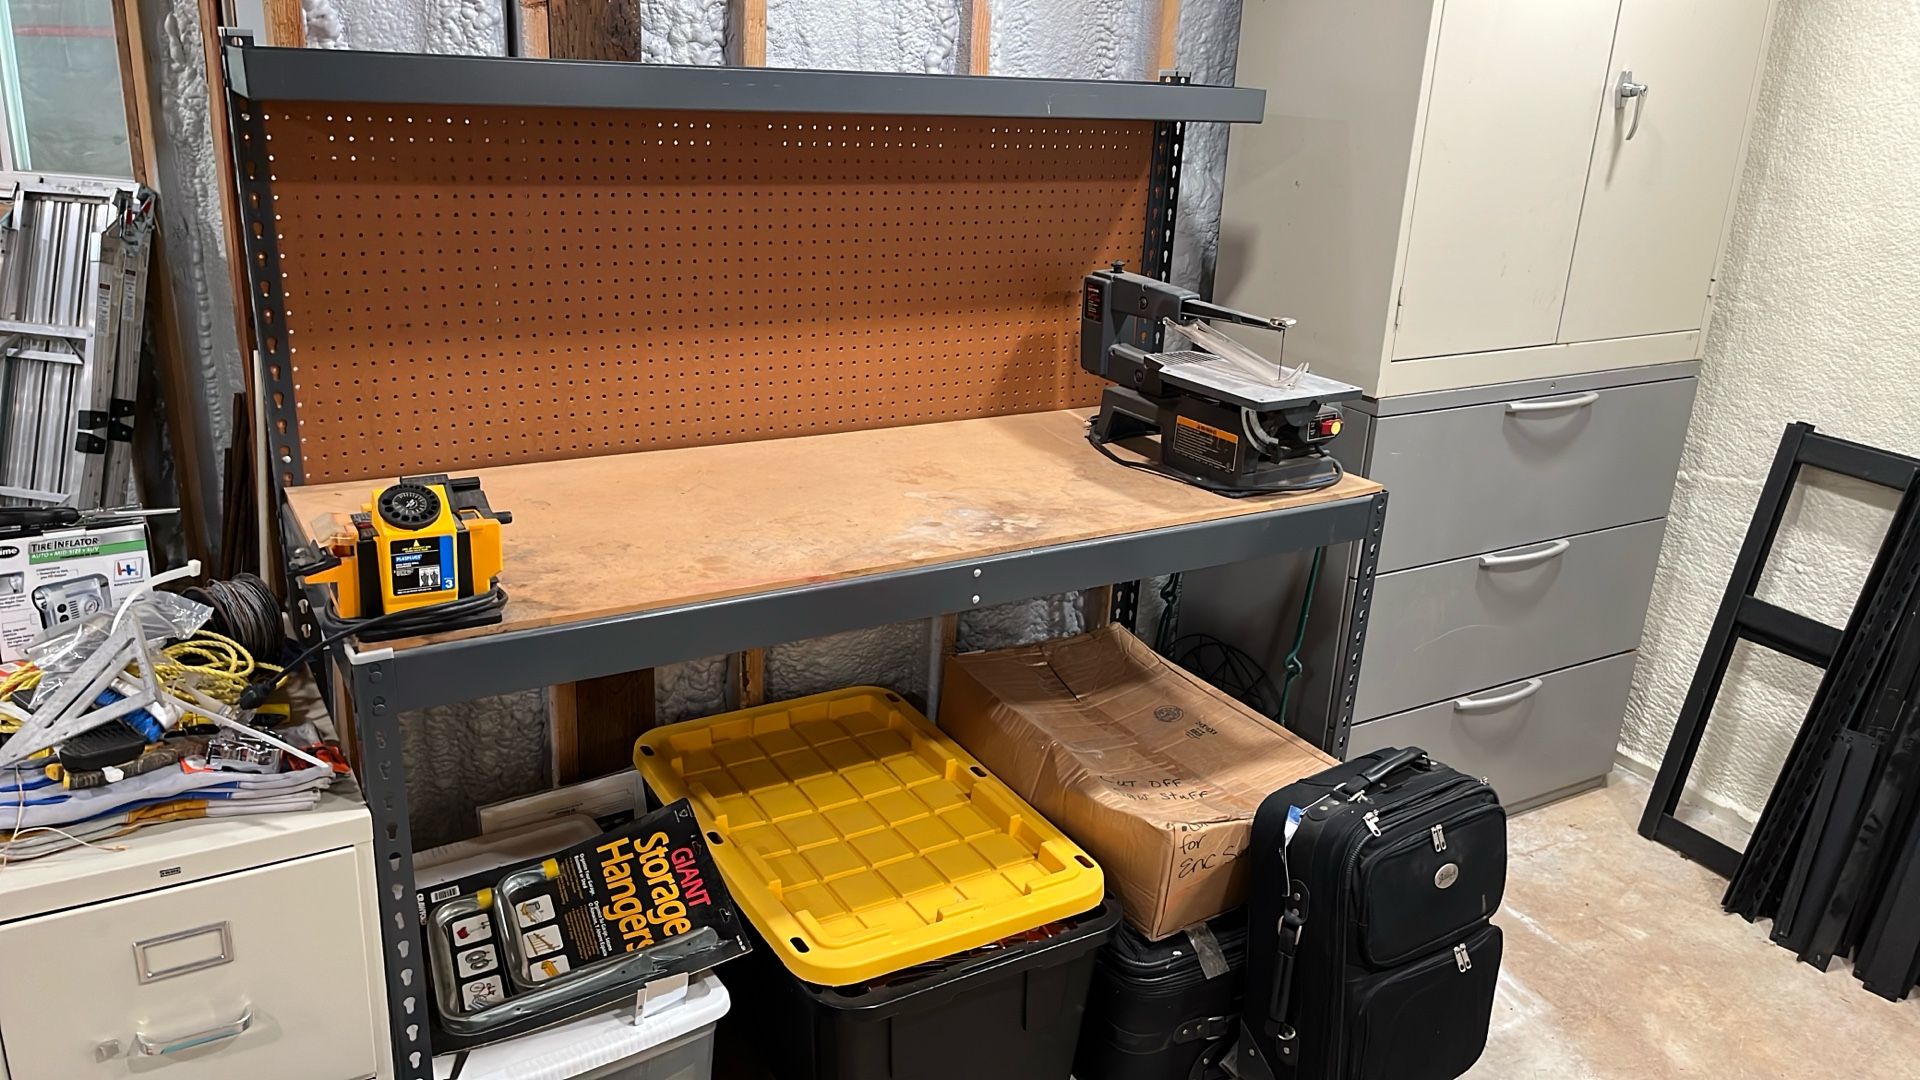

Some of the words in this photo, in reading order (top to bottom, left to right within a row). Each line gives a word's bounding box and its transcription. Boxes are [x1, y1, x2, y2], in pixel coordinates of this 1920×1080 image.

[32, 542, 52, 552] TIRE
[54, 538, 99, 550] INFLATOR
[445, 580, 453, 588] 3
[1179, 834, 1207, 854] for
[596, 837, 655, 952] Hangers
[633, 831, 692, 937] Storage
[671, 847, 712, 906] GIANT
